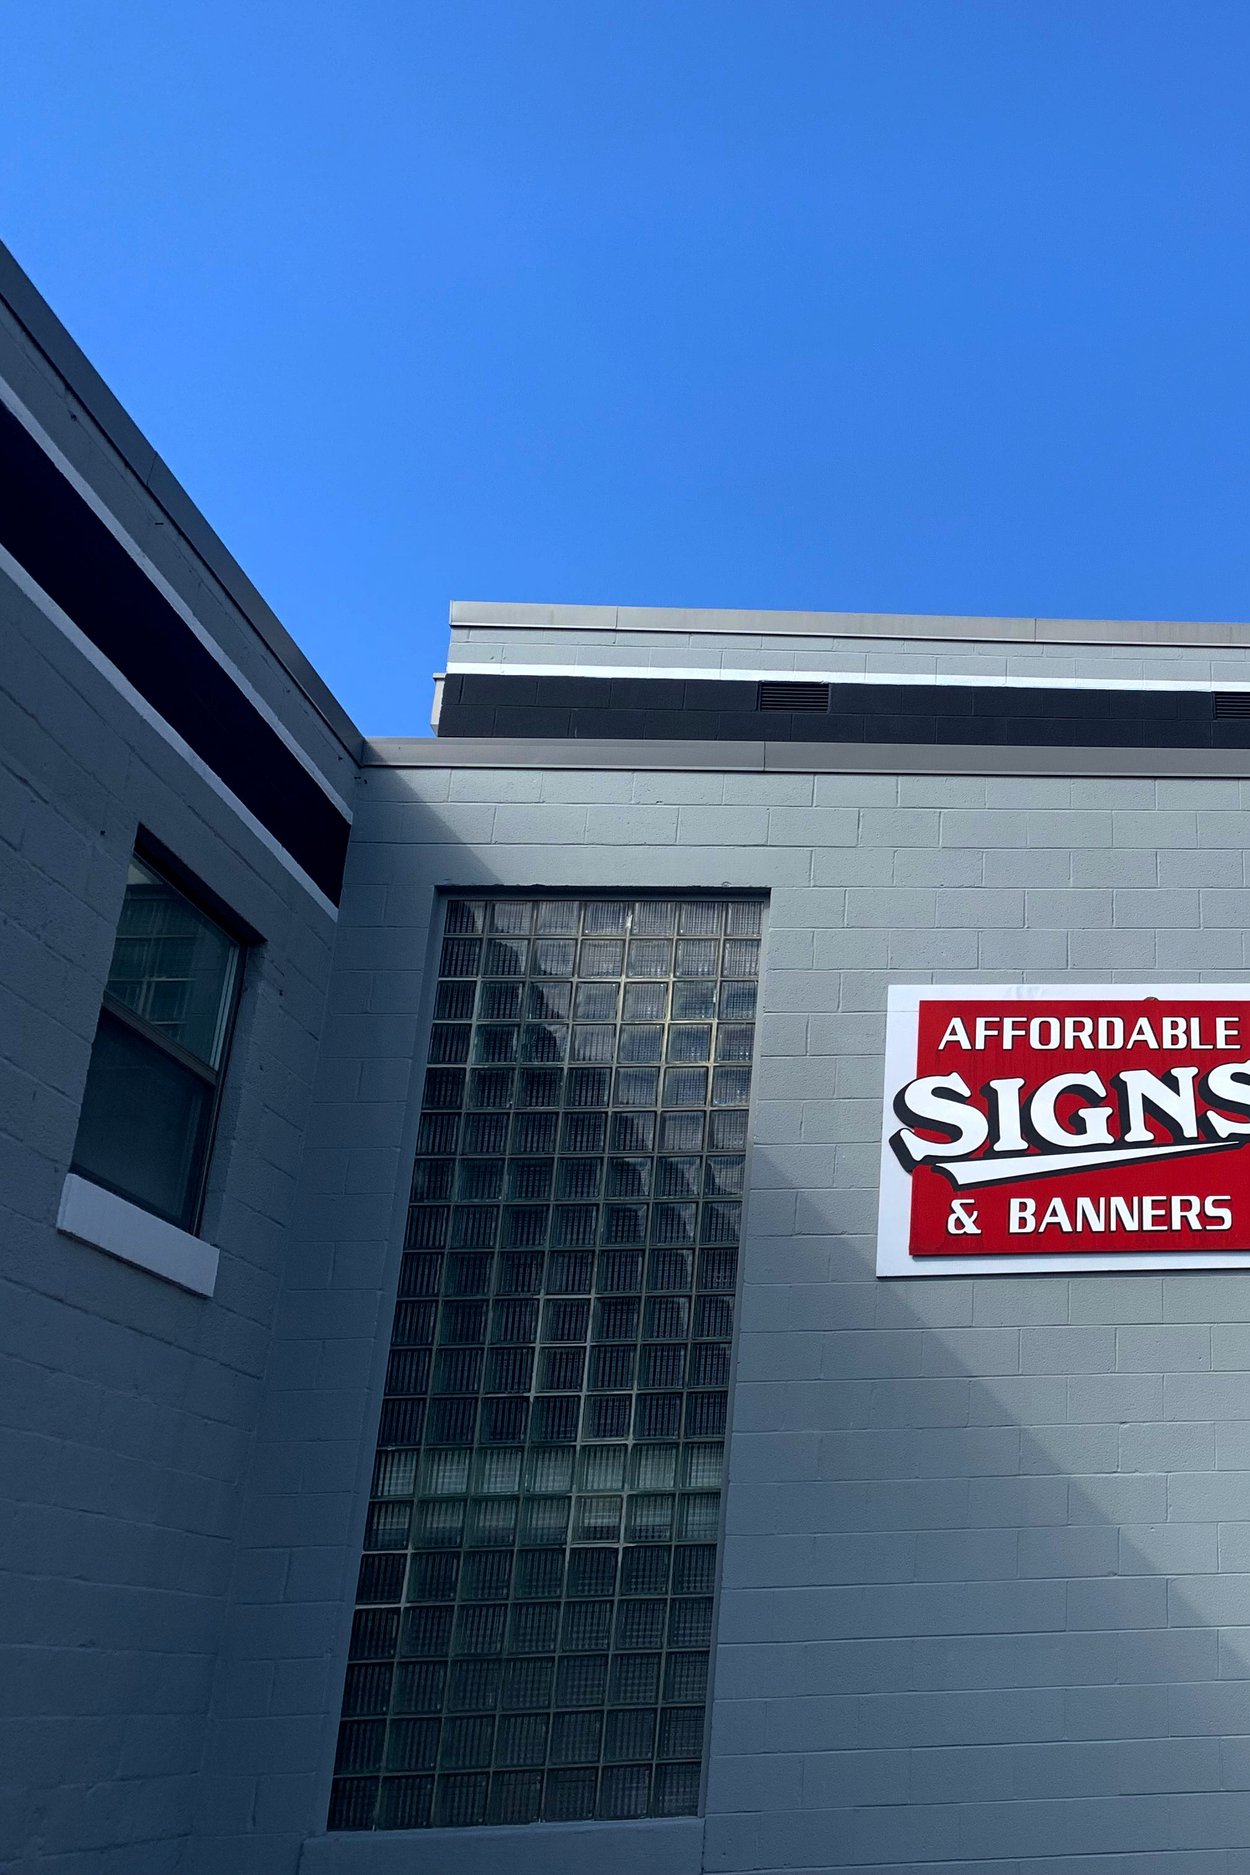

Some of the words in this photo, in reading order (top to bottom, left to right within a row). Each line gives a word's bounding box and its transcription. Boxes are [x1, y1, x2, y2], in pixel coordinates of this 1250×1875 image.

[938, 1016, 1241, 1050] AFFORDABLE
[946, 1198, 982, 1235] &
[1009, 1195, 1232, 1233] BANNERS
